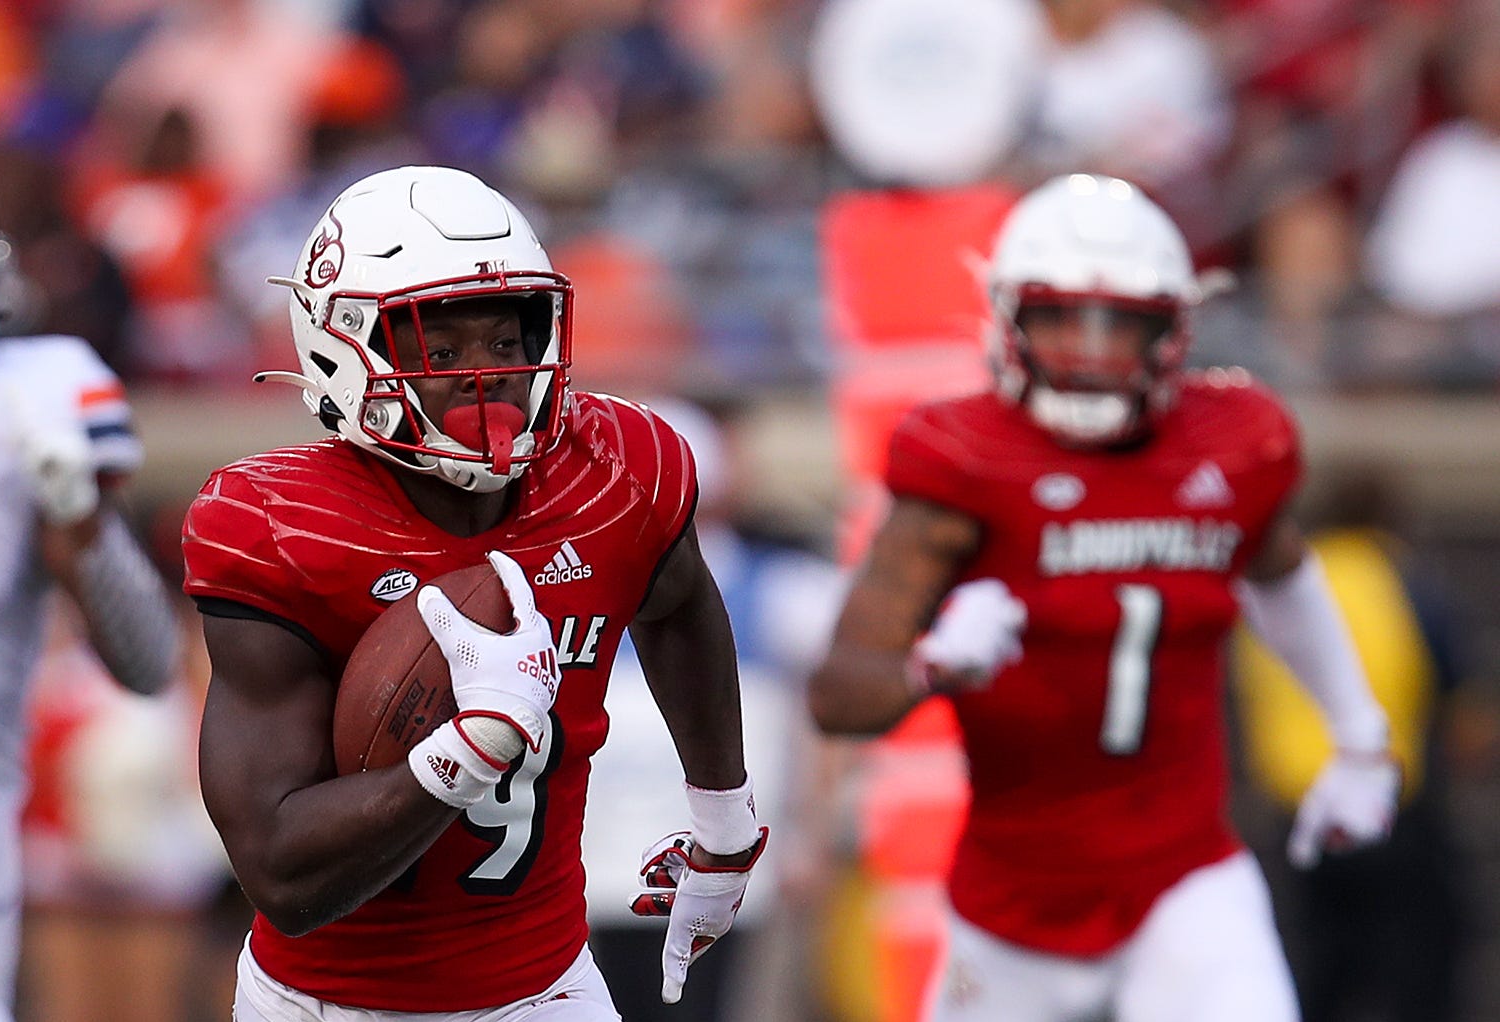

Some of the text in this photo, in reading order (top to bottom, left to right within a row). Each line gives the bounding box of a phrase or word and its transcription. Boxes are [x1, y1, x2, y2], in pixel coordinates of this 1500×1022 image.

[375, 571, 413, 596] ACC
[533, 563, 593, 587] adidas
[1100, 584, 1162, 755] 1
[426, 754, 457, 791] adidas
[458, 706, 562, 895] 9
